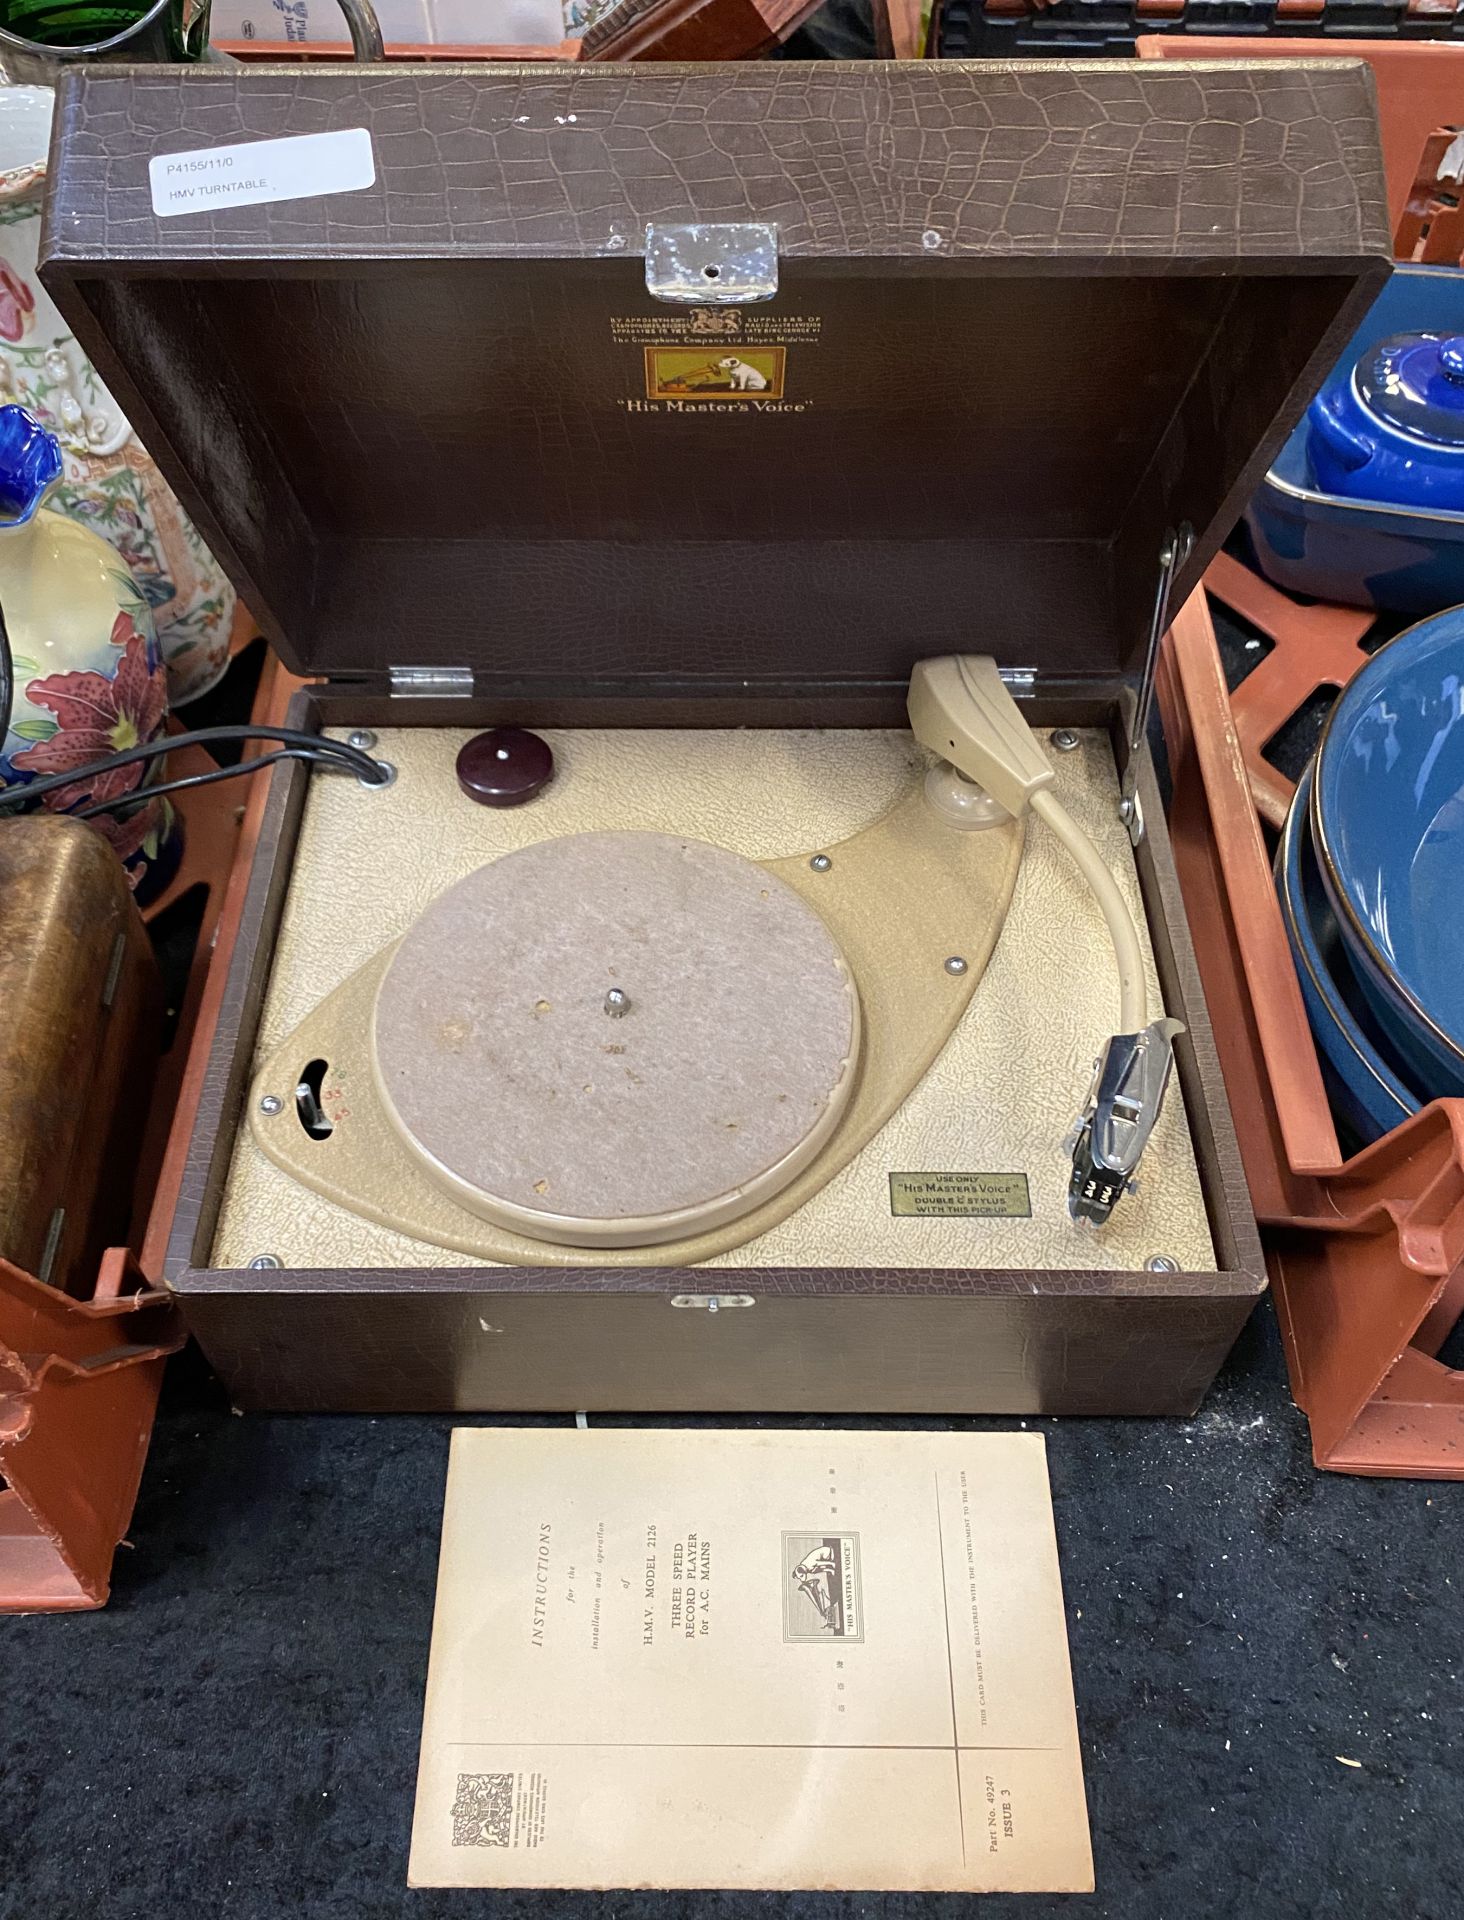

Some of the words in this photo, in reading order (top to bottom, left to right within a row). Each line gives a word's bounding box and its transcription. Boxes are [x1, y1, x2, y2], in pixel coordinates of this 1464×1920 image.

[167, 157, 233, 175] P4155/11/0
[169, 188, 195, 200] HMV
[198, 179, 268, 195] TURNTABLE
[665, 400, 749, 412] Master's
[752, 400, 814, 412] Voice"
[936, 1175, 954, 1183] USE
[596, 1522, 605, 1563] operation
[647, 1524, 656, 1548] 2126
[964, 1519, 974, 1563] INSTRUMENT
[673, 1543, 683, 1580] SPEED
[687, 1532, 697, 1579] PLAYER
[700, 1541, 711, 1581] MAINS
[567, 1566, 575, 1579] the
[594, 1571, 602, 1588] and
[620, 1578, 630, 1589] of
[645, 1555, 656, 1598] MODEL
[531, 1523, 552, 1647] INSTRUCTIONS
[565, 1589, 575, 1604] for
[671, 1587, 682, 1629] THREE
[700, 1589, 709, 1612] A.C.
[590, 1598, 601, 1650] installation
[685, 1587, 696, 1639] RECORD
[643, 1606, 654, 1646] H.M.V.
[699, 1620, 709, 1635] for
[971, 1605, 980, 1646] DELIVERED
[976, 1661, 984, 1682] MUST
[978, 1684, 986, 1706] CARD
[985, 1776, 995, 1804] 49247
[1000, 1789, 1011, 1797] 3
[988, 1808, 997, 1827] No.
[1002, 1802, 1013, 1838] ISSUE
[989, 1831, 998, 1853] Part
